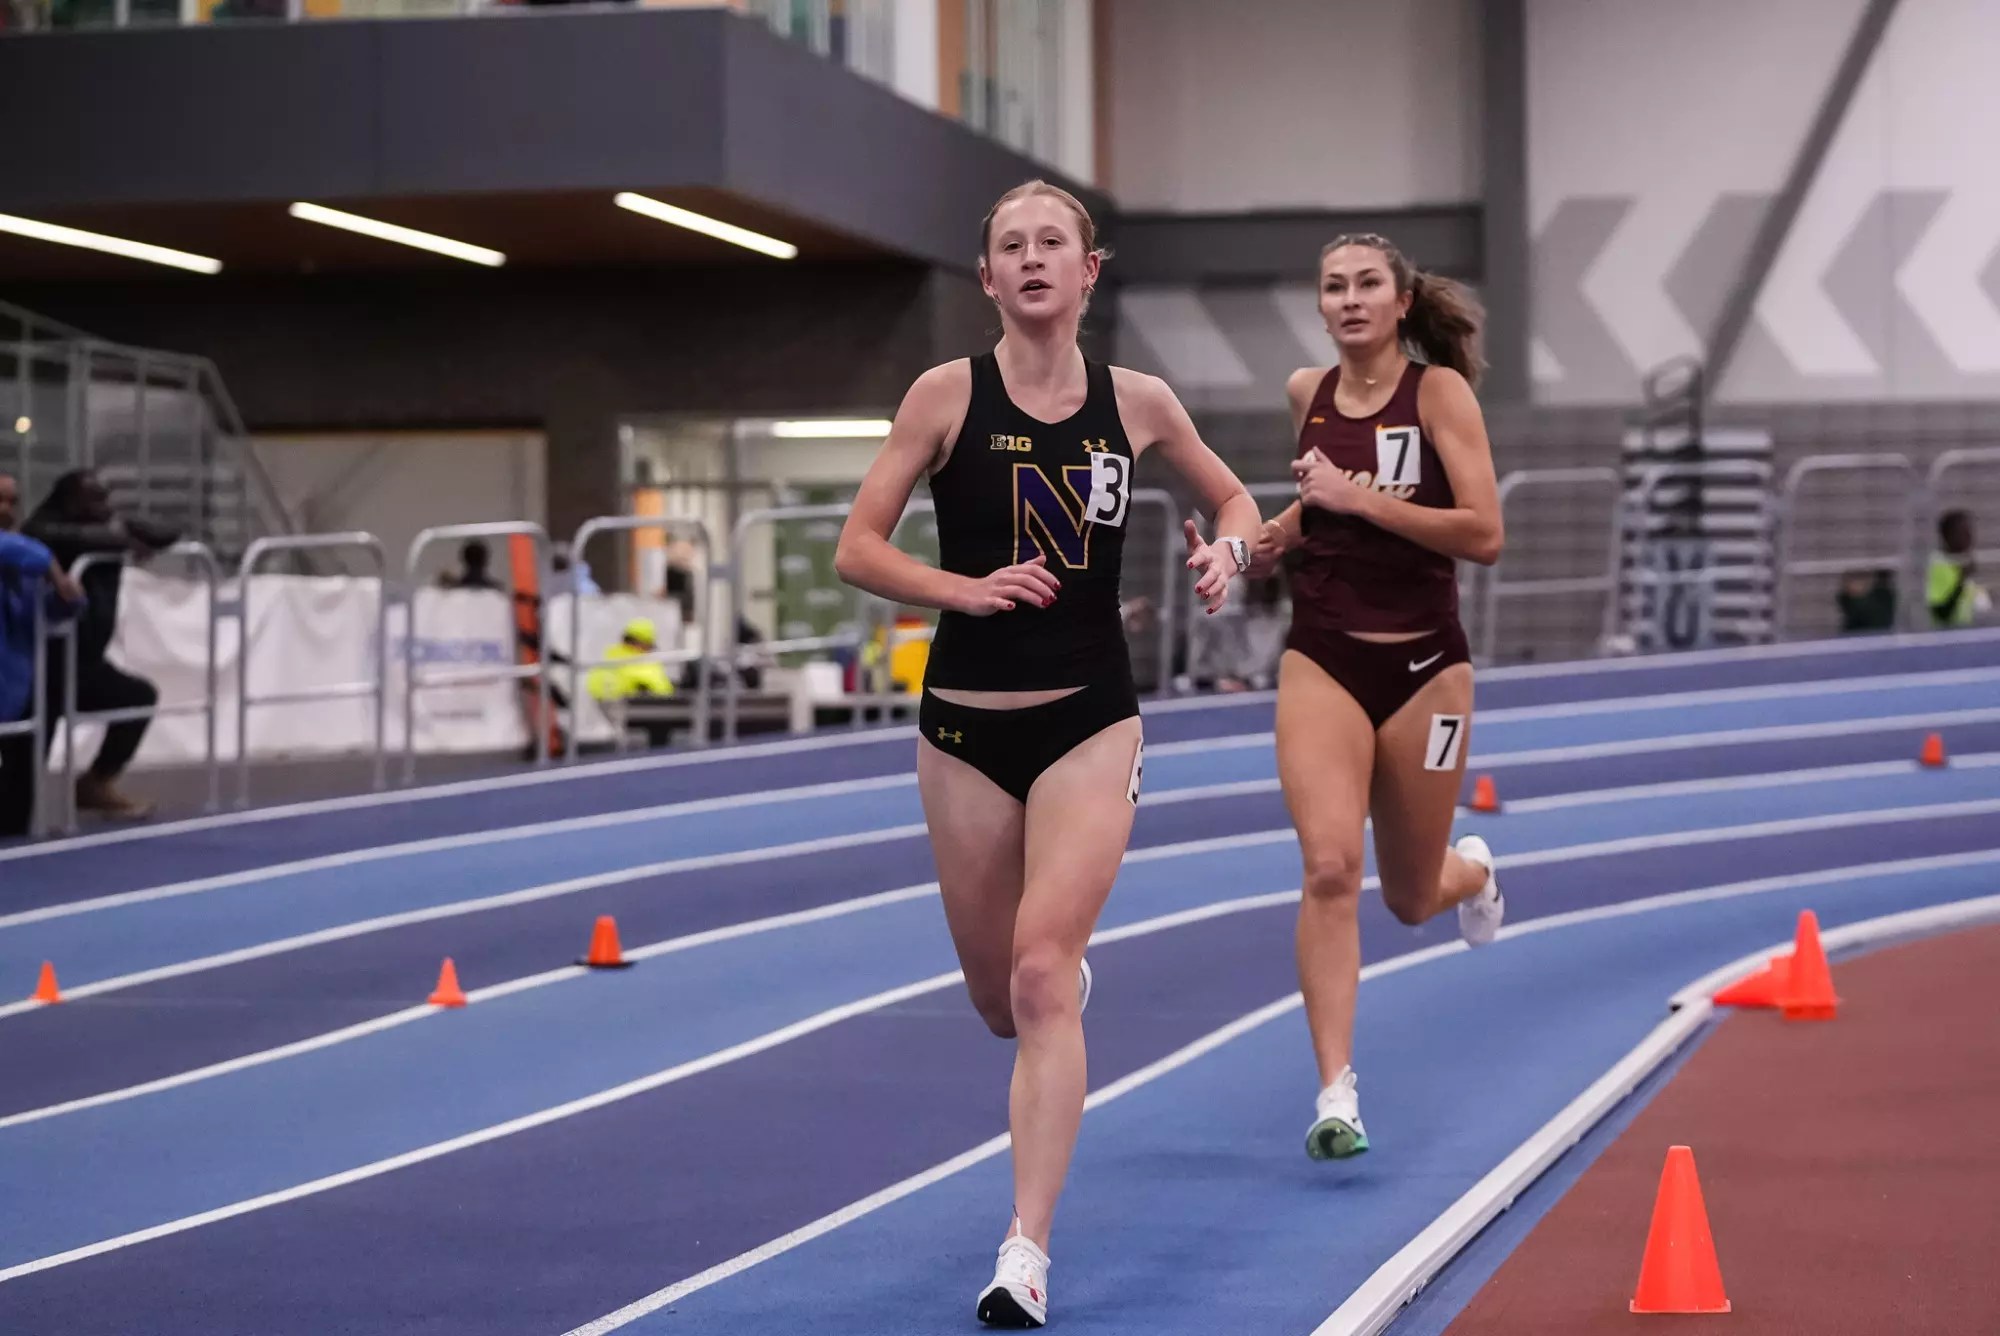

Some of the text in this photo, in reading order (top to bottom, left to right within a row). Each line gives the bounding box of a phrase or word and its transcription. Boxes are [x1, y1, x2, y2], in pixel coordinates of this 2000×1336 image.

[1387, 432, 1410, 481] 7
[1013, 463, 1094, 569] N
[1096, 458, 1123, 521] 3
[1436, 719, 1459, 767] 7
